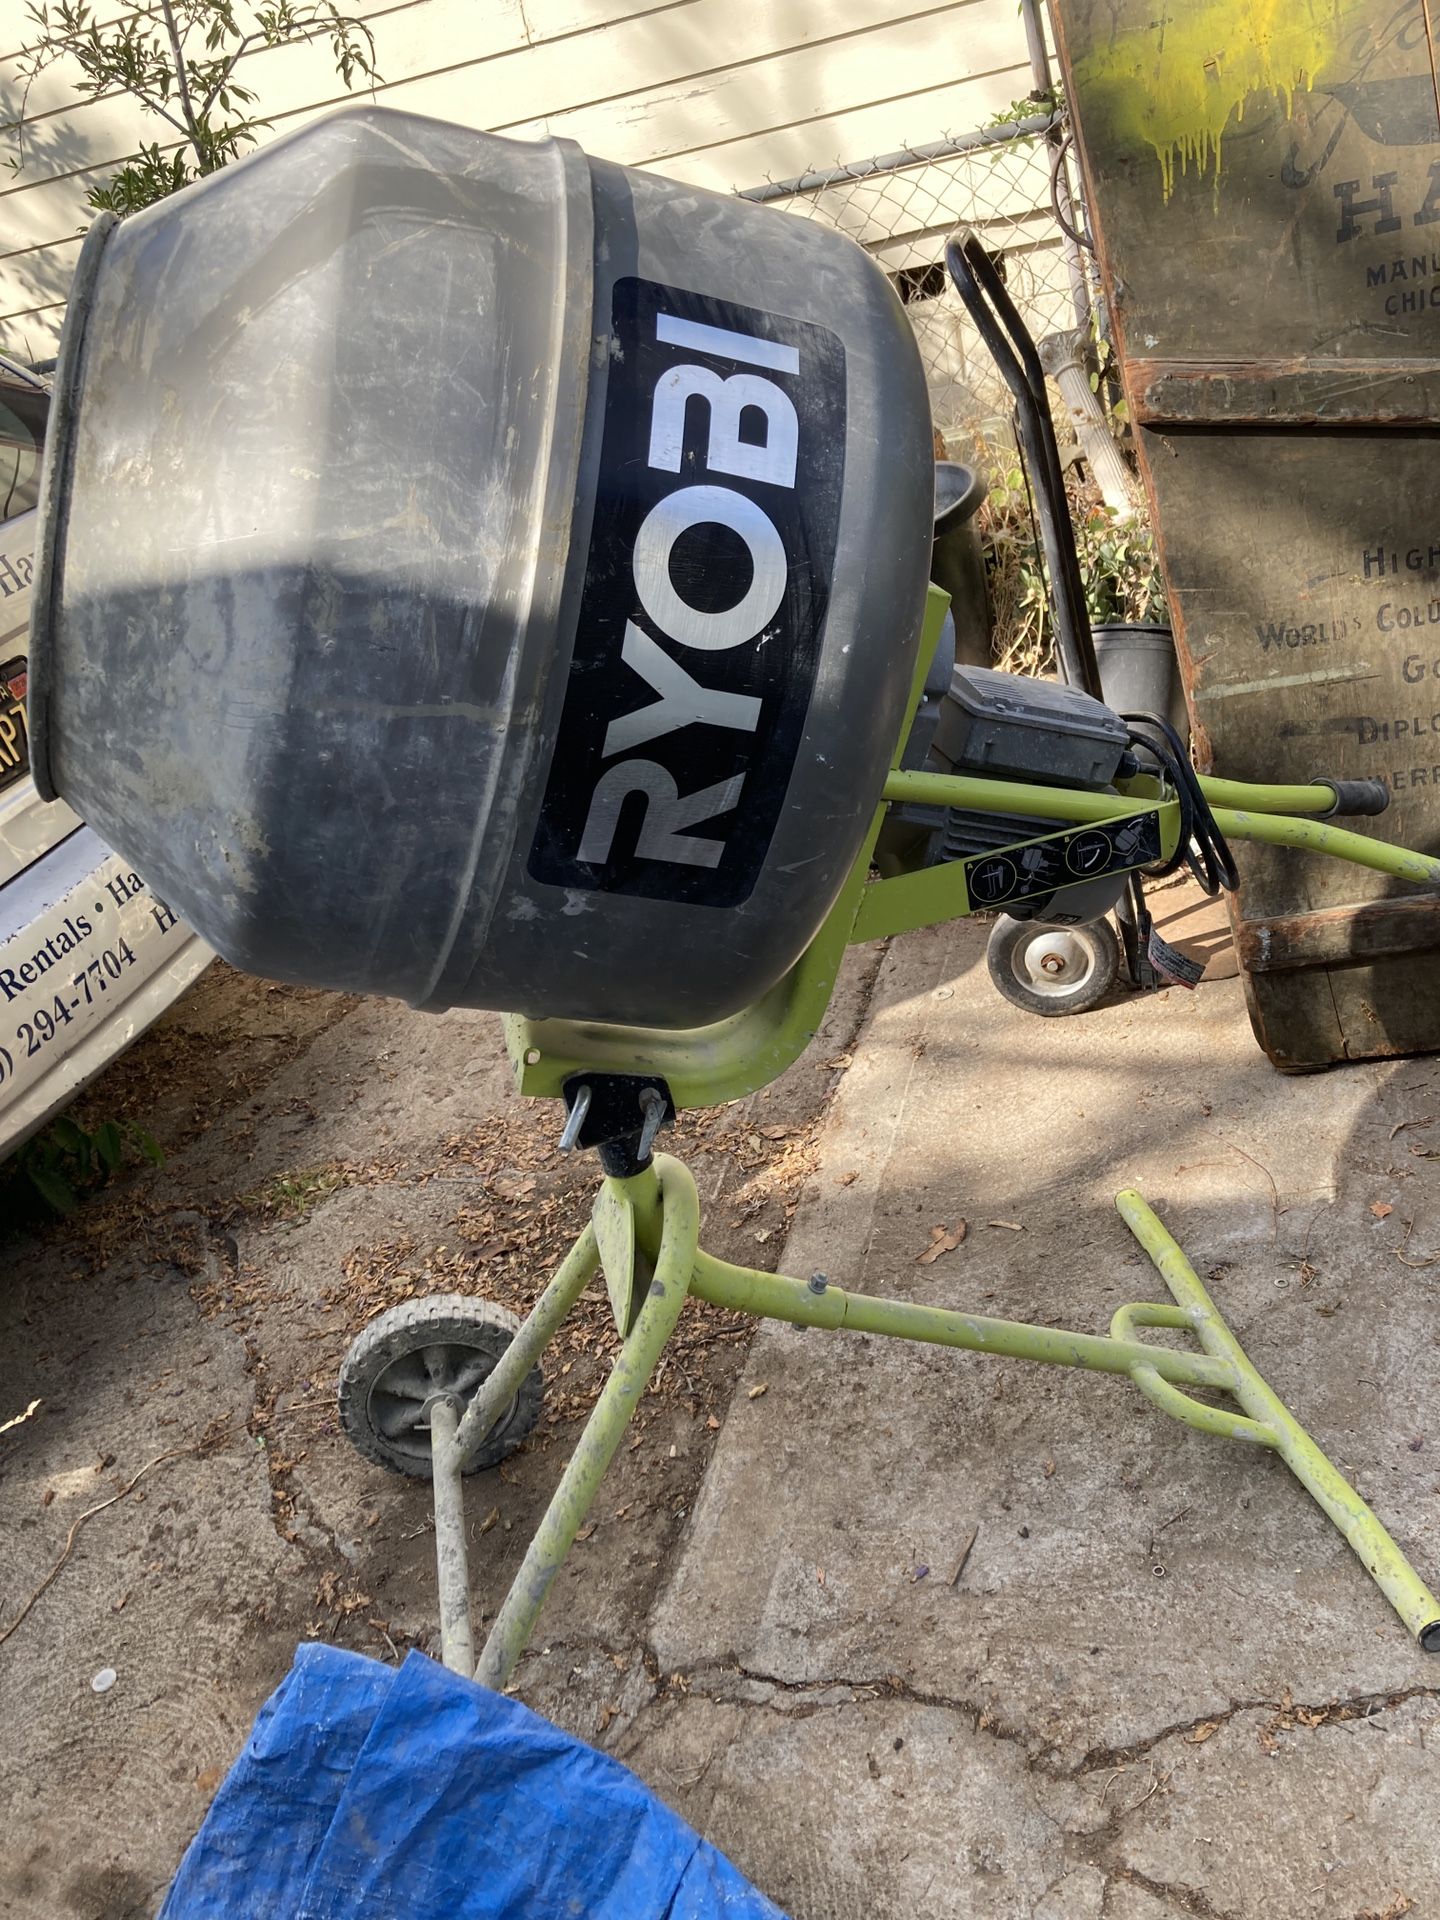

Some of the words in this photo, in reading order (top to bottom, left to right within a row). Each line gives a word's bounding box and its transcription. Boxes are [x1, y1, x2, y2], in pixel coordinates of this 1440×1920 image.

[0, 553, 34, 598] Ha
[576, 312, 799, 868] RYOBI
[0, 914, 93, 1002] Rentals
[16, 936, 137, 1058] 294-7704
[150, 904, 181, 935] H
